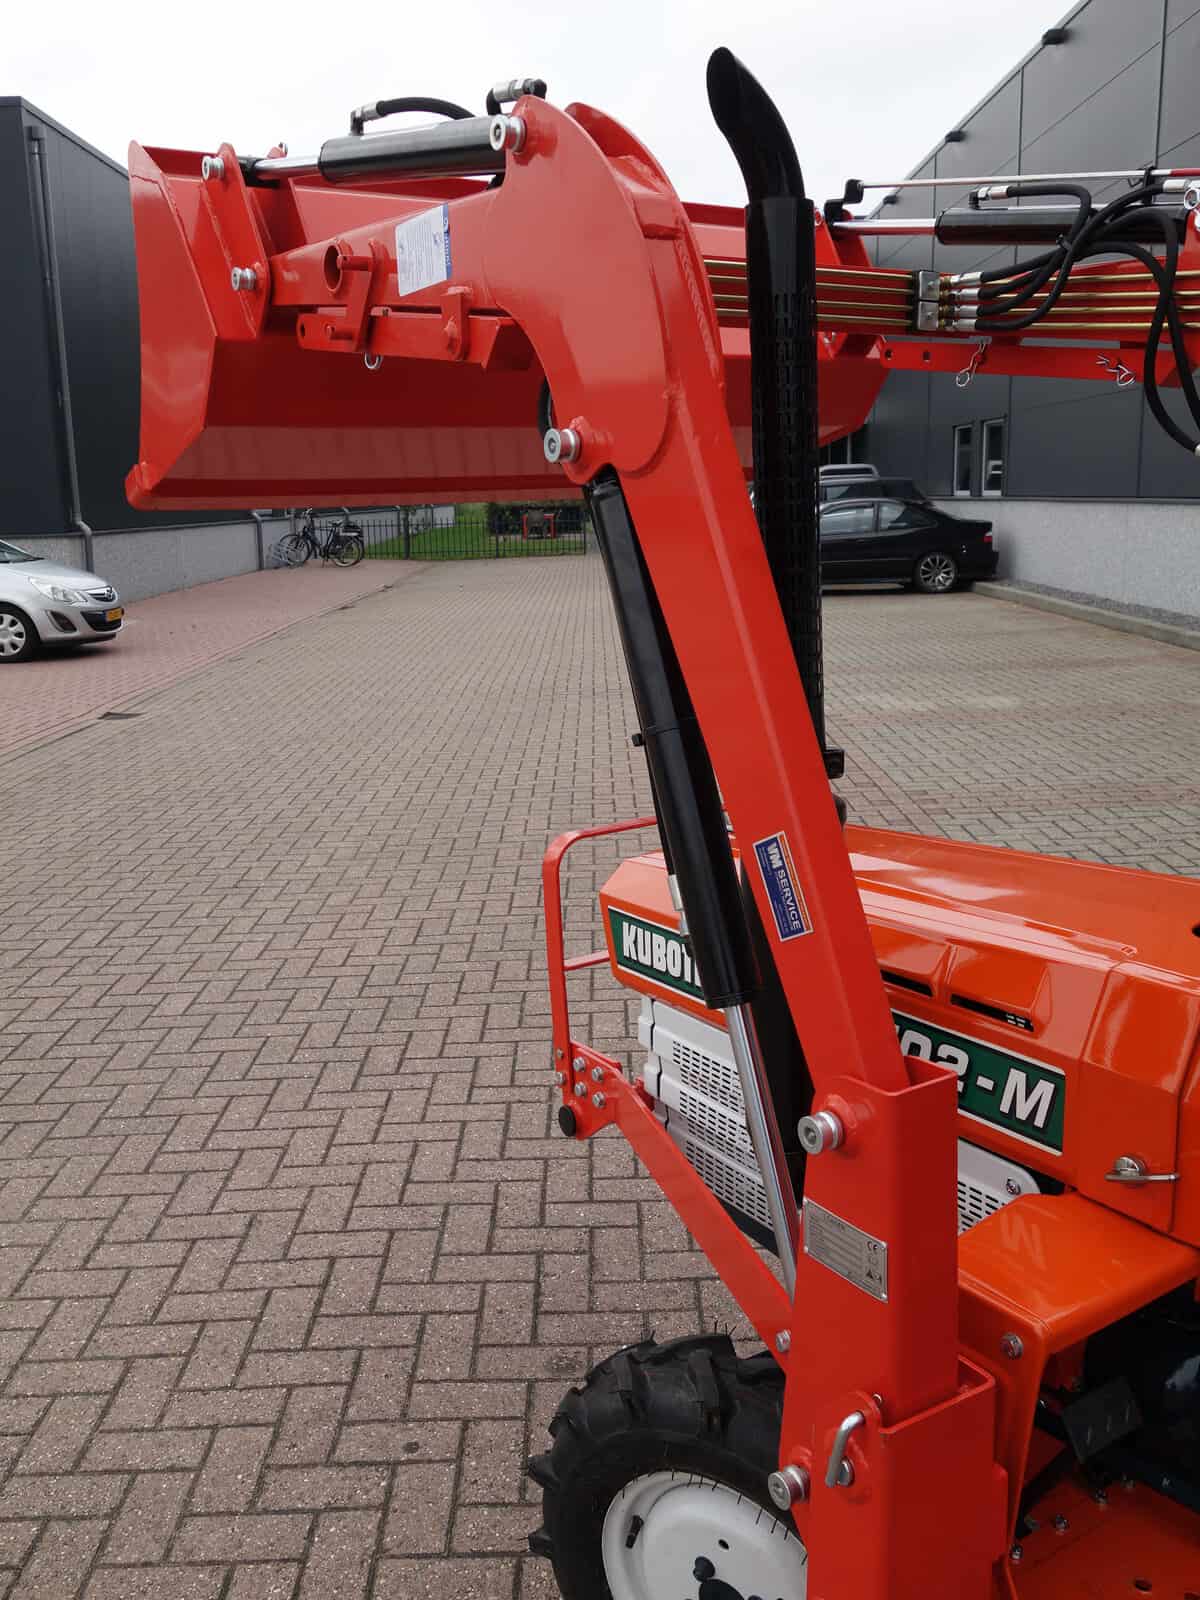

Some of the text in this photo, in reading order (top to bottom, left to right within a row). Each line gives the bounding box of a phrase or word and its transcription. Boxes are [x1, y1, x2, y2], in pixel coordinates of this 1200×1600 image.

[778, 869, 801, 929] SERVICE
[622, 920, 702, 988] KUBOT
[895, 1024, 1056, 1129] 02-M
